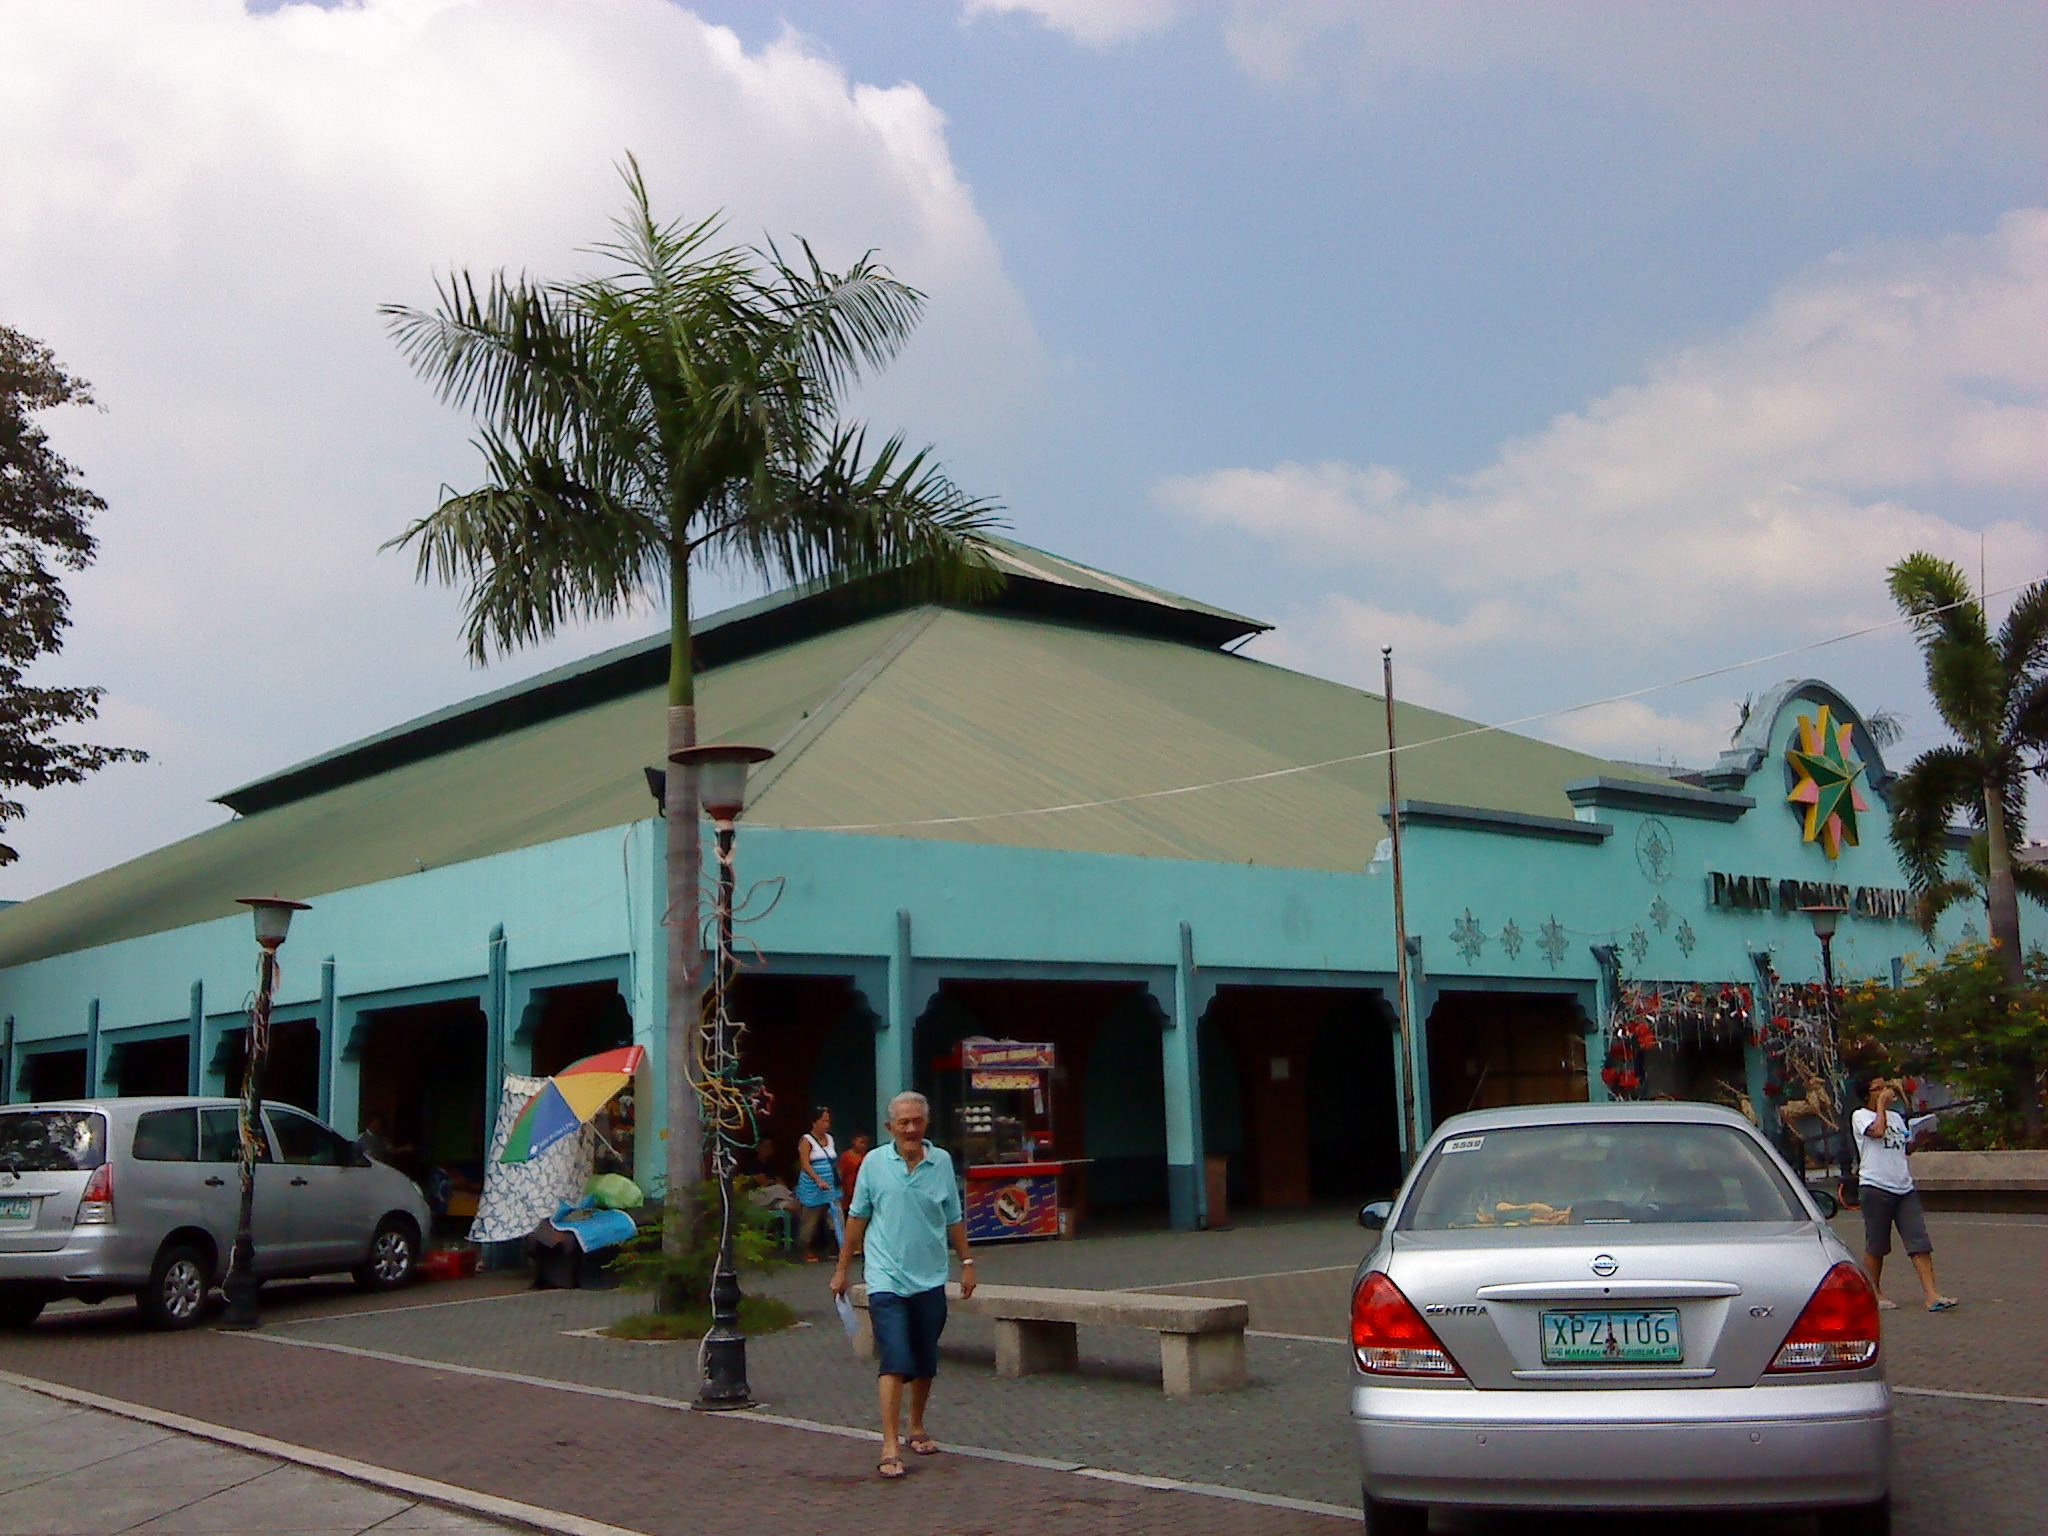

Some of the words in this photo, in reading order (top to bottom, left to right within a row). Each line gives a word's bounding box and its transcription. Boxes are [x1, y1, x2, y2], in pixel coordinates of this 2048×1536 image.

[1425, 1303, 1488, 1317] SENTRA
[1749, 1305, 1774, 1318] GX
[1553, 1318, 1603, 1345] XPZ
[1623, 1318, 1671, 1345] 106
